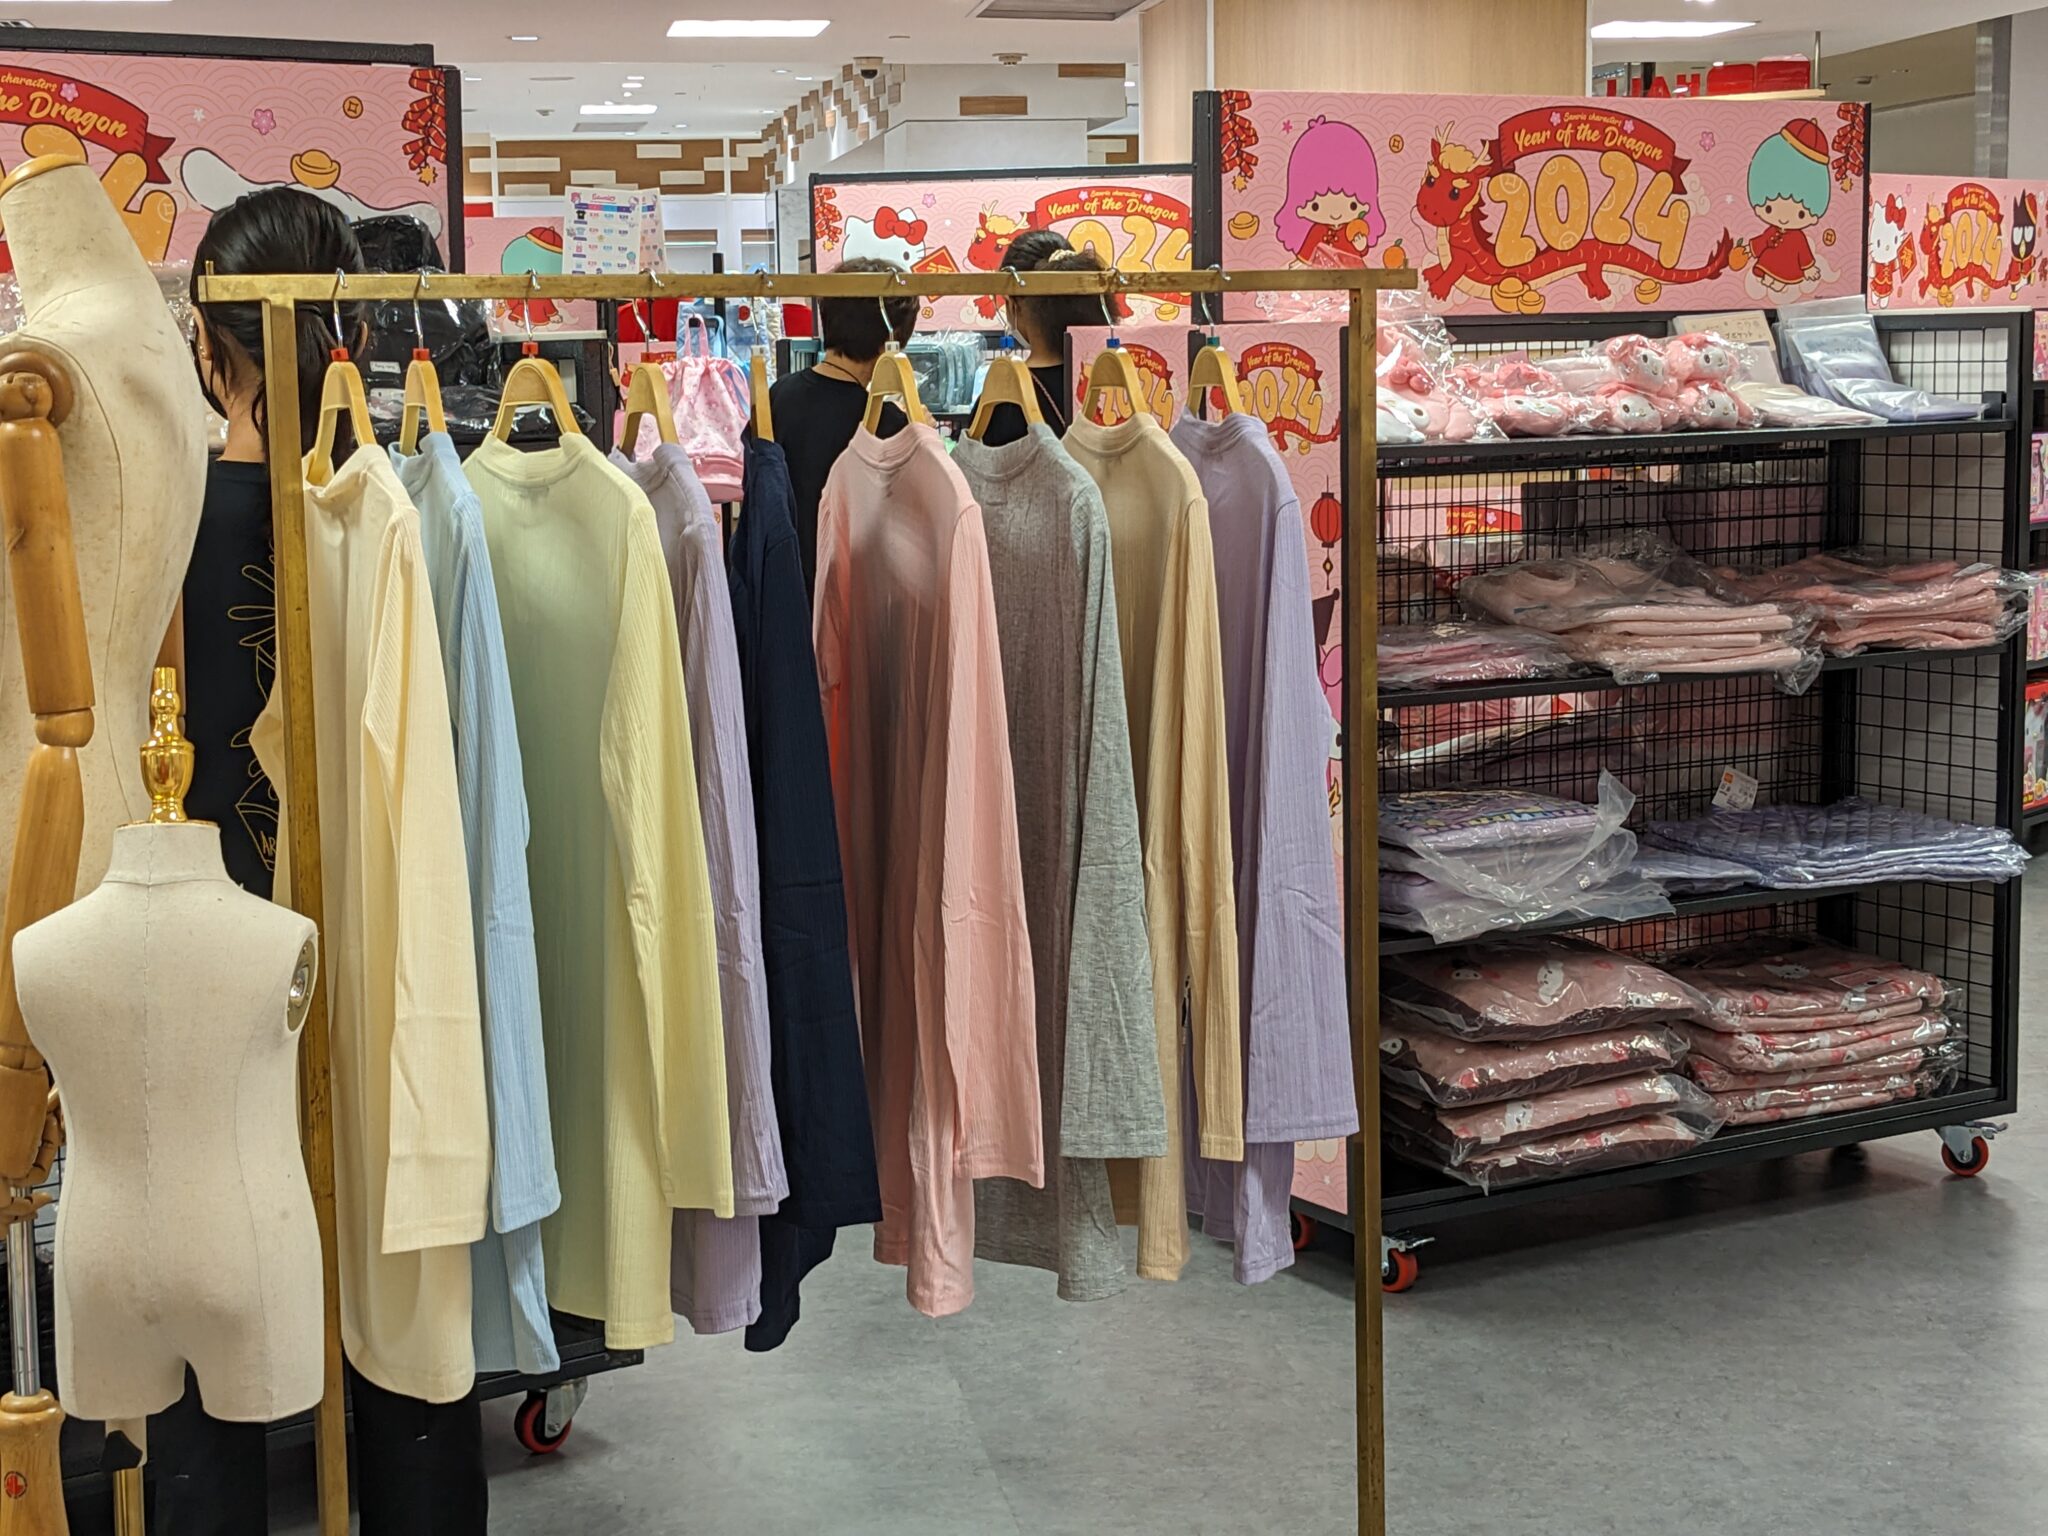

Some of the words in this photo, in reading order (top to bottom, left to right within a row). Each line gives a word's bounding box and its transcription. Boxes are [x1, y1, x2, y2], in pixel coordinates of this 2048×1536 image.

[1, 73, 57, 92] characters
[0, 87, 23, 112] he
[28, 91, 128, 138] Dragon
[1514, 128, 1551, 152] Year
[1555, 123, 1575, 148] of
[1576, 122, 1602, 142] the
[1603, 126, 1664, 160] Dragon
[1048, 202, 1079, 219] Year
[1084, 199, 1099, 215] of
[1102, 197, 1124, 211] the
[1126, 199, 1180, 221] Dragon
[1487, 150, 1691, 269] 2024
[1941, 210, 2003, 280] 2024
[1247, 355, 1262, 369] Year
[1264, 352, 1272, 365] of
[1272, 352, 1283, 362] the
[1284, 353, 1310, 372] Dragon
